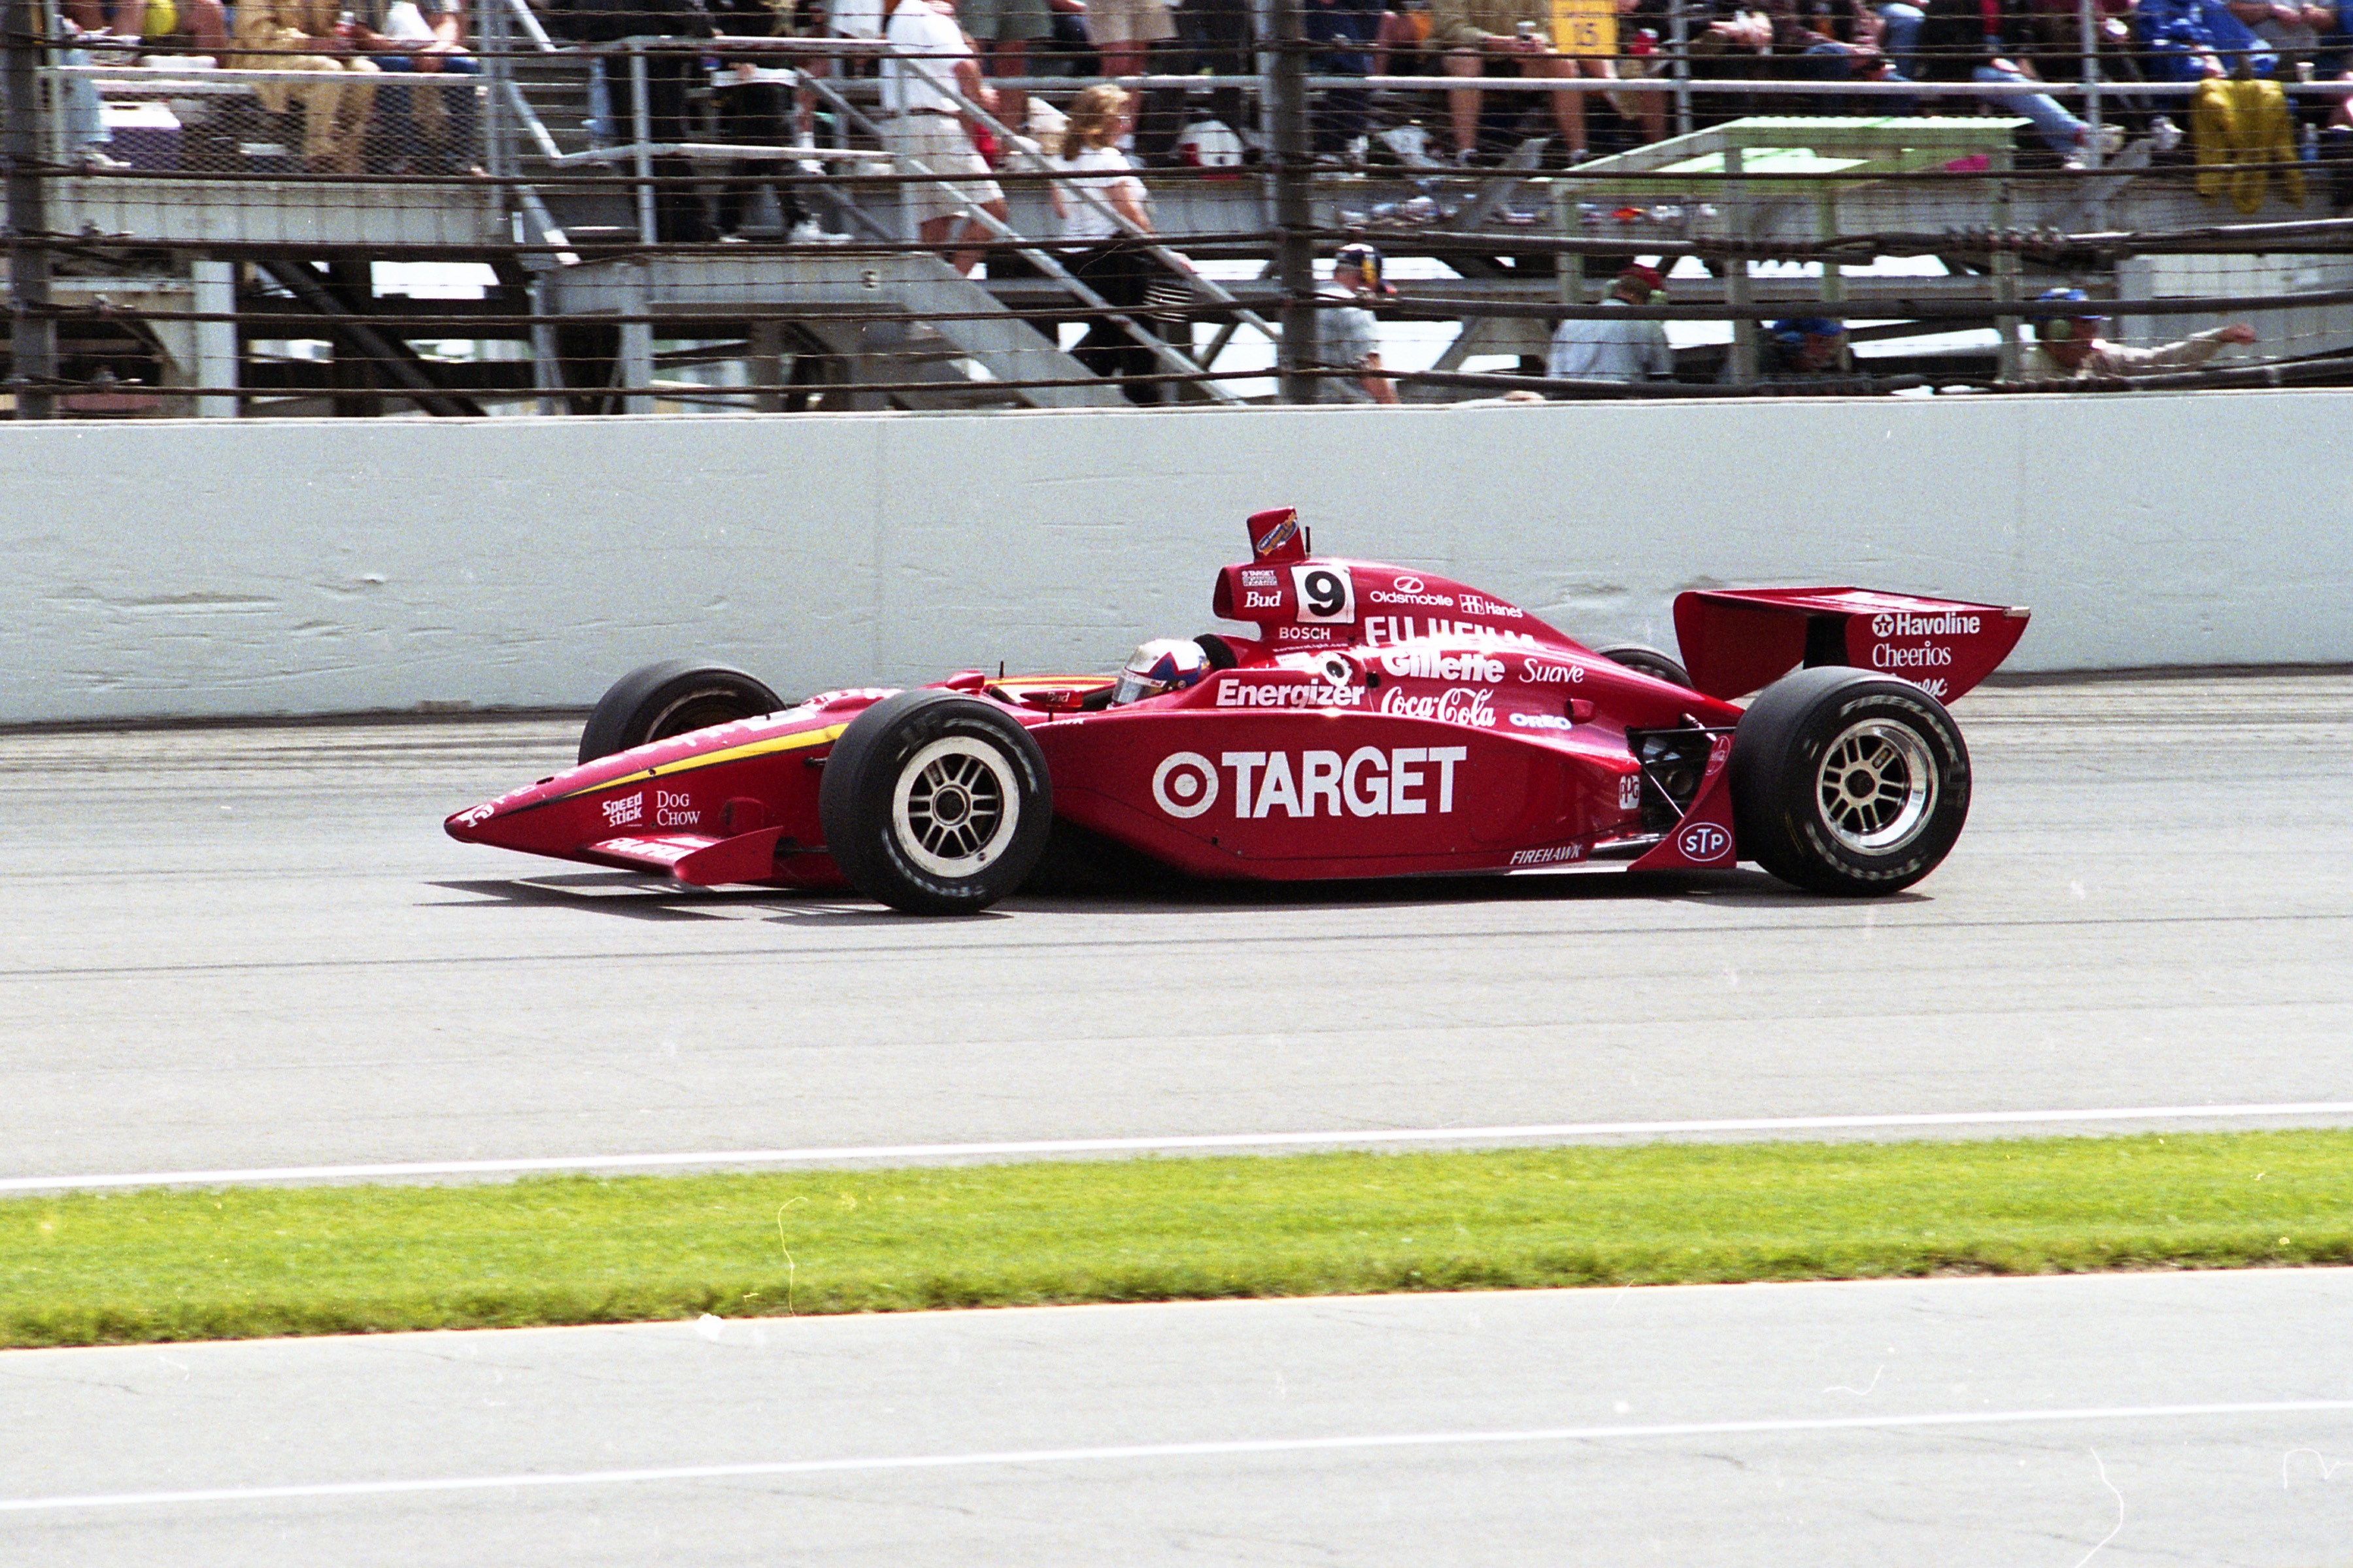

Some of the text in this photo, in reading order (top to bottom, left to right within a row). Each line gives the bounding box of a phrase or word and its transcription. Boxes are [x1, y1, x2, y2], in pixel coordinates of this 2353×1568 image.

[1244, 591, 1282, 607] Bud
[1305, 571, 1346, 617] 9
[1370, 591, 1453, 607] Oldsmobile
[1485, 601, 1523, 618] Hanes
[1279, 627, 1330, 639] BOSCH
[1896, 612, 1980, 635] Havoline
[1381, 650, 1505, 682] Gillette
[1872, 641, 1952, 667] Cheerios
[1519, 658, 1583, 683] Suave
[1216, 678, 1364, 709] Energizer
[1381, 686, 1496, 727] Coca-Cola
[1509, 712, 1572, 730] OREO
[1221, 746, 1467, 818] TARGET
[1685, 828, 1723, 854] STP
[1510, 844, 1583, 865] FIREHAWK
